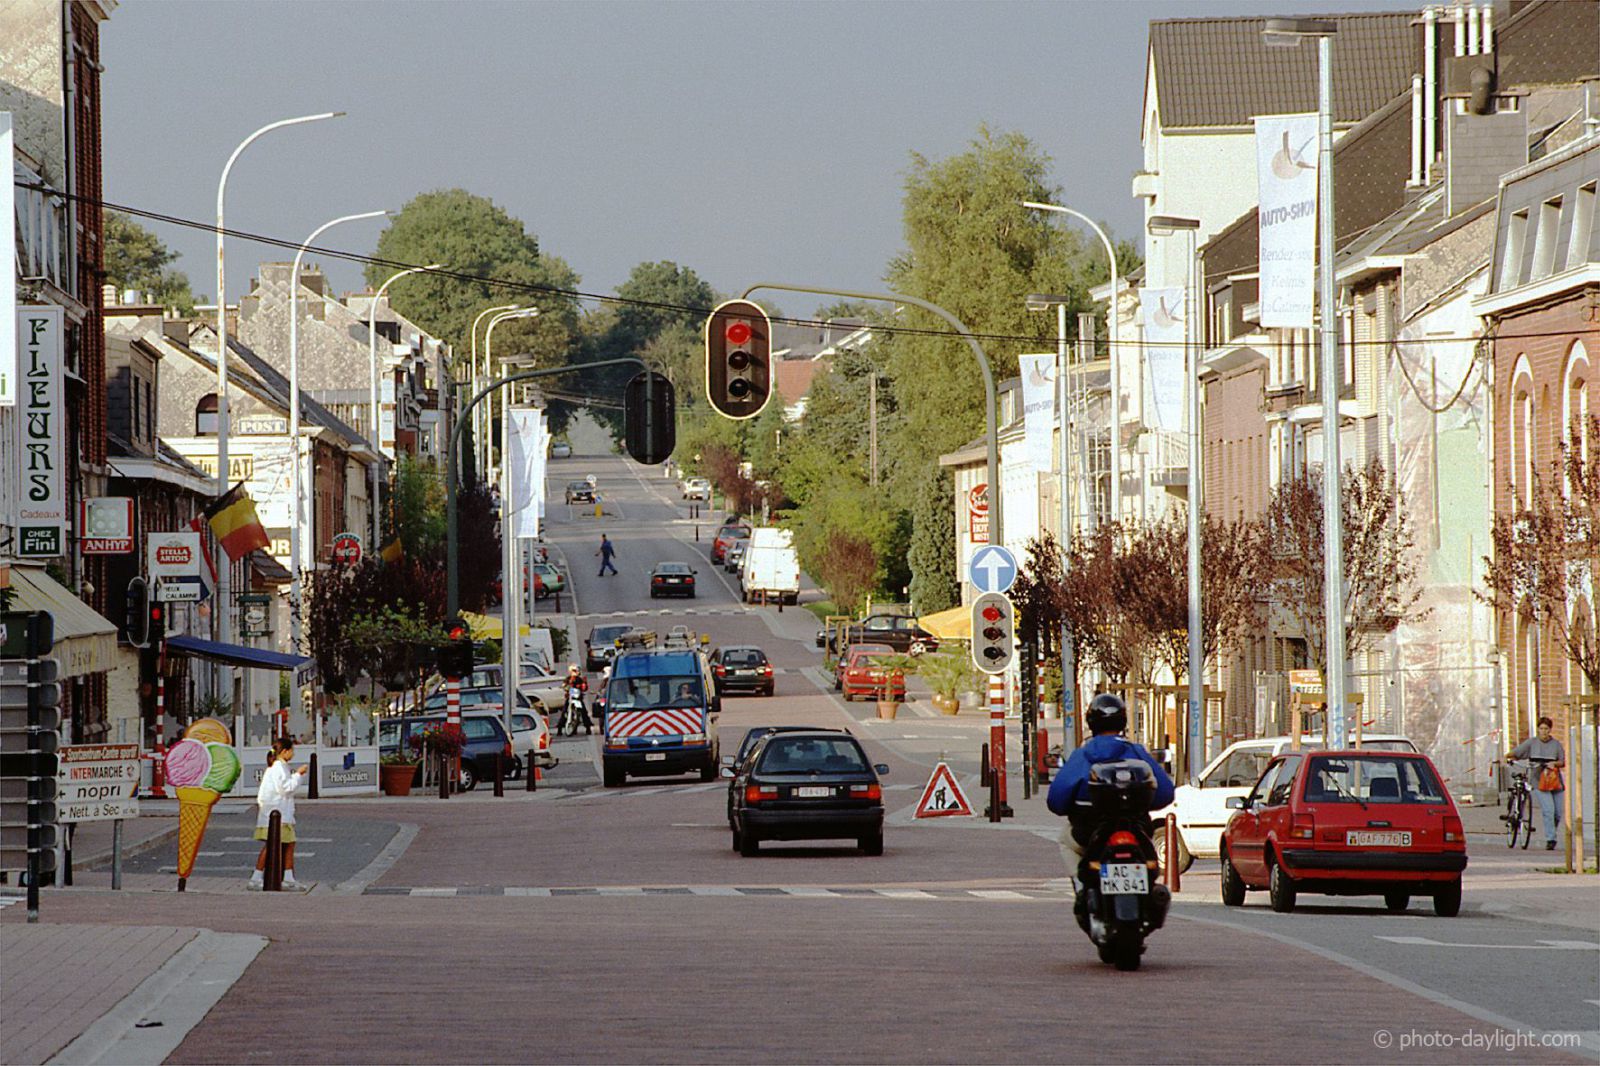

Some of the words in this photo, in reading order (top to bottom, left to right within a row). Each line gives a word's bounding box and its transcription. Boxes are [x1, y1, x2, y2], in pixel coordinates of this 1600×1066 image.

[27, 318, 53, 501] FLEURS
[20, 509, 60, 519] Cadeaux
[27, 530, 52, 538] CHEZ
[24, 538, 56, 551] Fini
[85, 540, 129, 551] ANHYP
[330, 771, 368, 784] Hoegaarden
[77, 785, 121, 800] nopri
[102, 803, 120, 816] Sec
[1402, 833, 1411, 845] B
[1113, 866, 1128, 878] AC
